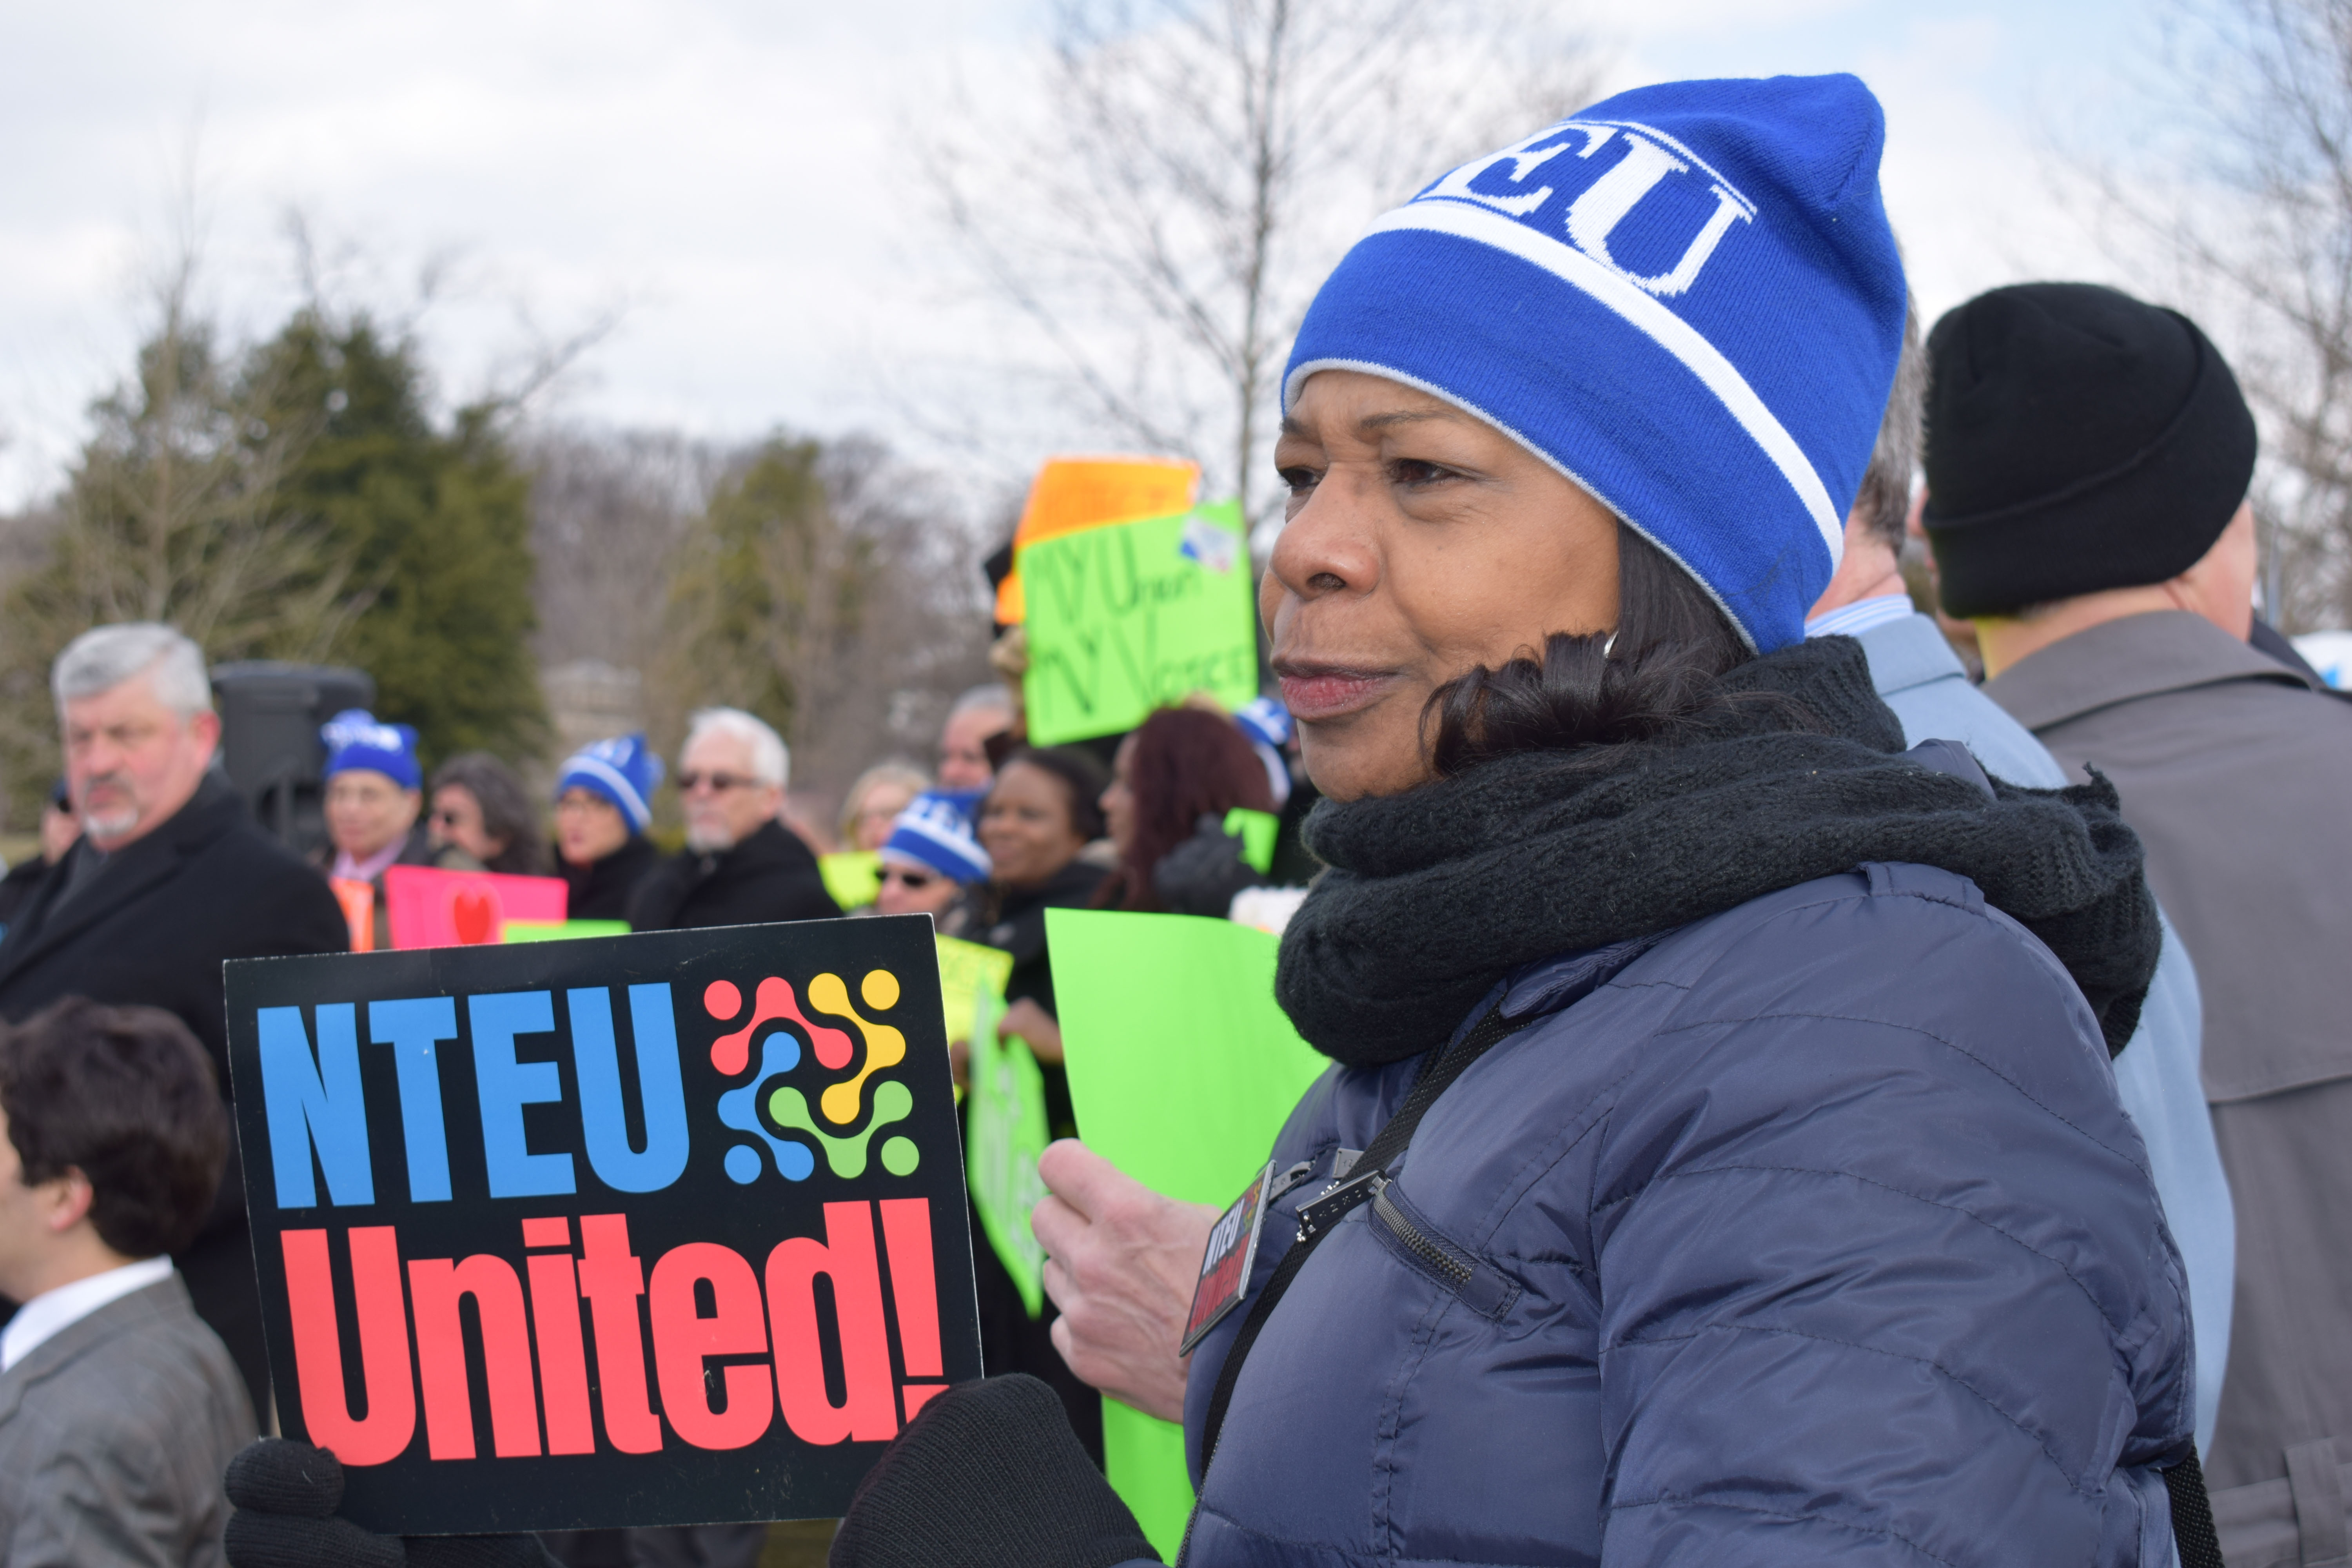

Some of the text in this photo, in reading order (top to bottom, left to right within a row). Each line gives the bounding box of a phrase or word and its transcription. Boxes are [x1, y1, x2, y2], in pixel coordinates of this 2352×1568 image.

[257, 982, 690, 1209] NTEU
[281, 1198, 950, 1466] United!
[1202, 1197, 1245, 1276] NTEU
